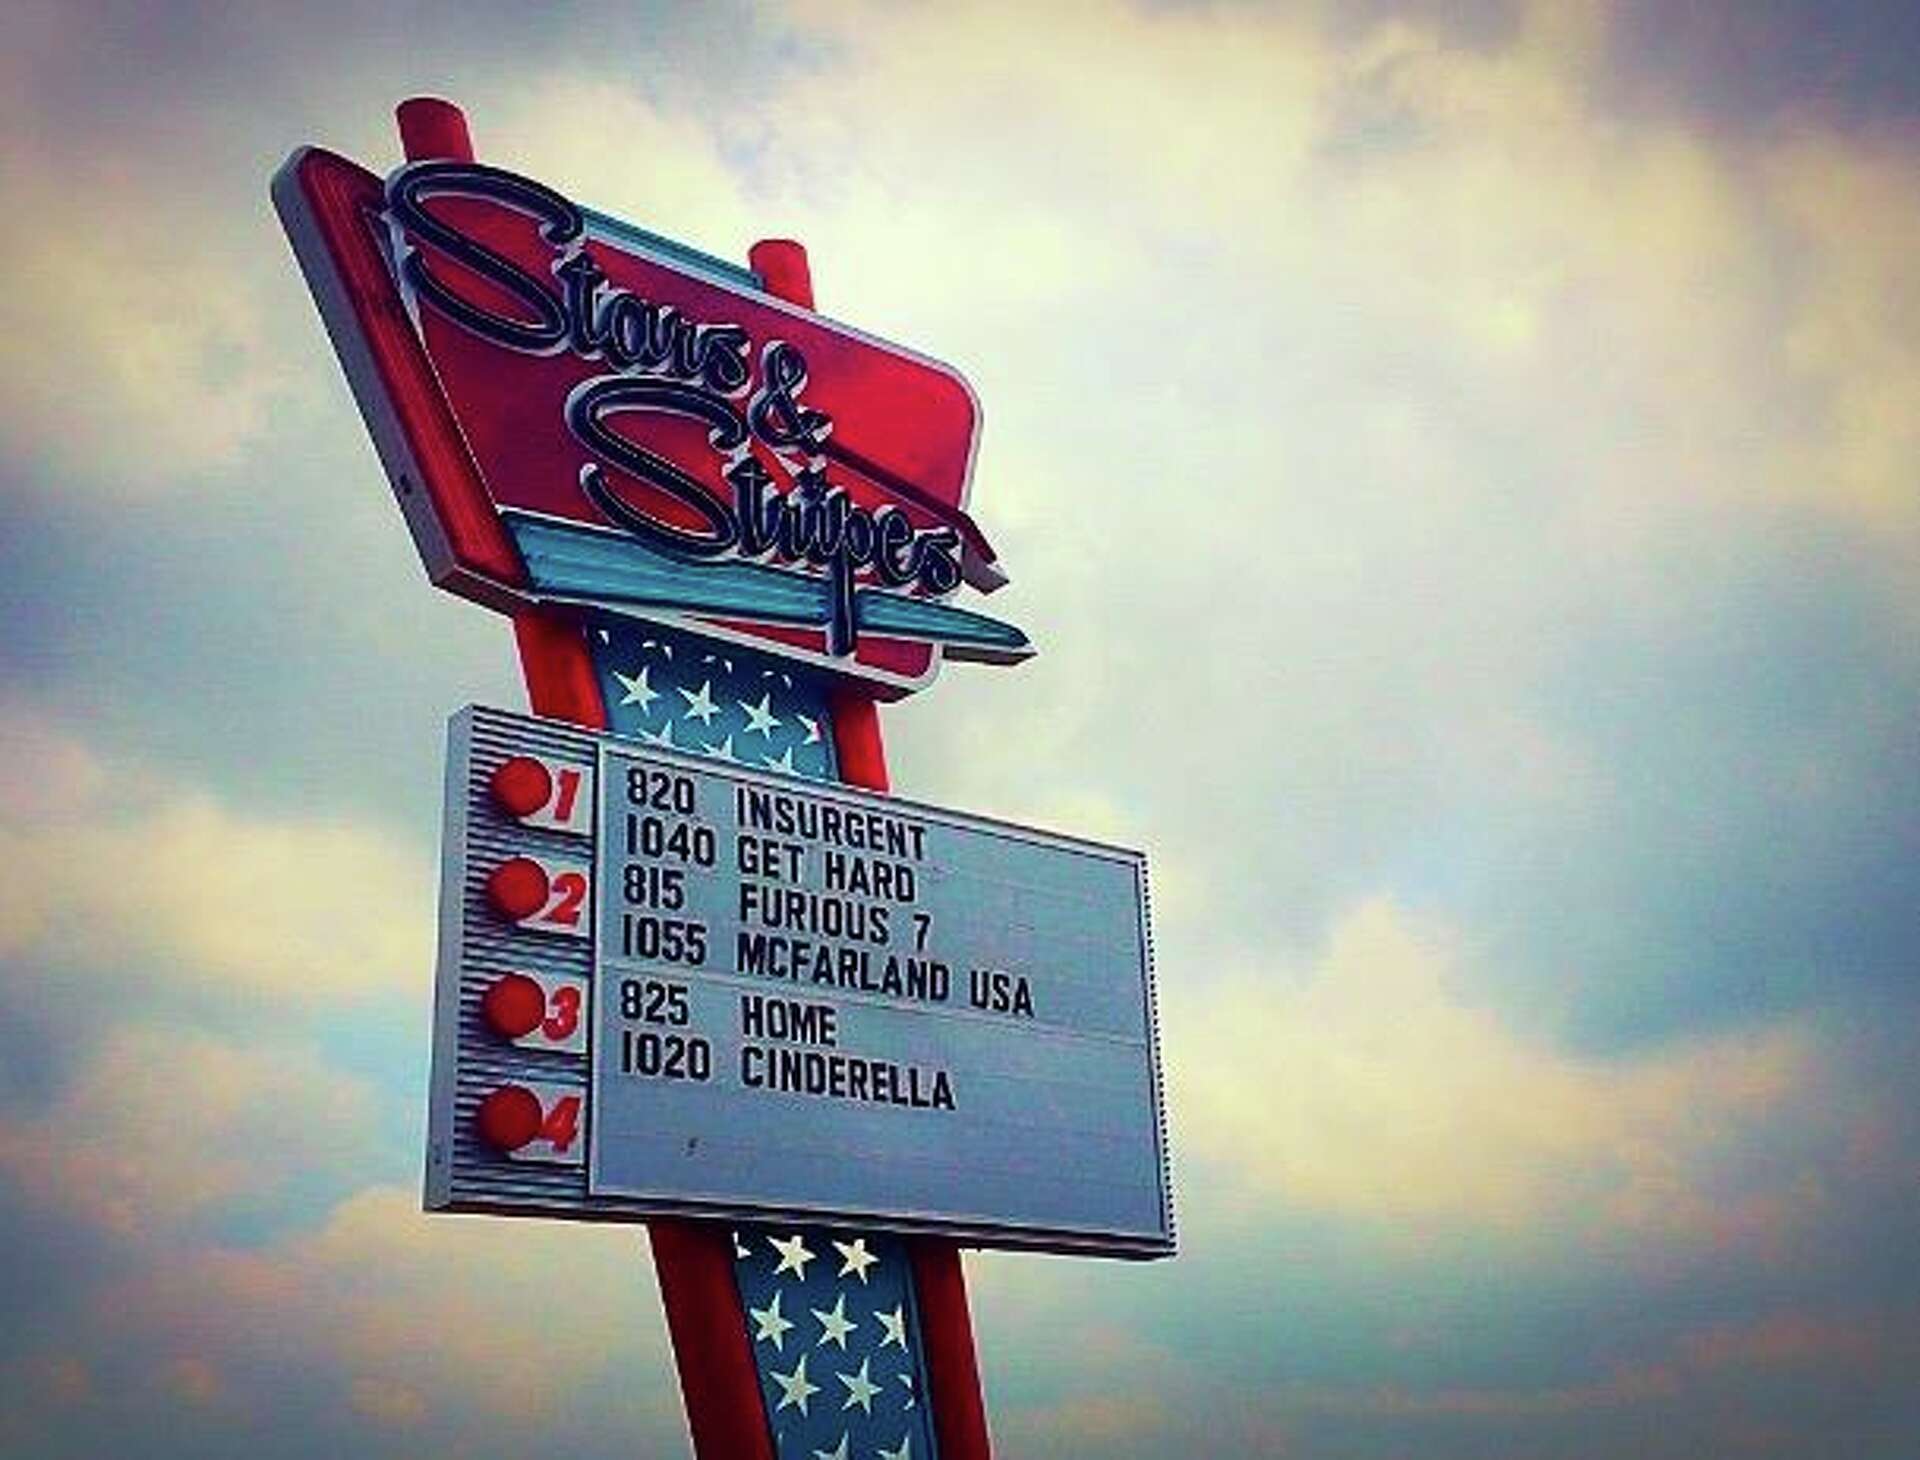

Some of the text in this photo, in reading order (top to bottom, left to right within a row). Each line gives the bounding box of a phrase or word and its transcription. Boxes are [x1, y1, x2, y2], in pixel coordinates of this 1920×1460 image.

[385, 159, 831, 452] Stars &
[566, 376, 964, 657] Stripes
[553, 770, 581, 822] 1
[626, 769, 927, 860] 820 INSURGENT
[540, 872, 587, 925] 2
[626, 814, 915, 902] 1040 GET HARD
[624, 864, 931, 951] 815 FURIOUS 7
[623, 914, 1034, 1017] 1055 MCFARLAND USA
[542, 987, 580, 1041] 3
[620, 980, 837, 1046] 825 HOME
[621, 1031, 956, 1110] 1020 CINDERELLA
[539, 1096, 581, 1152] 4
